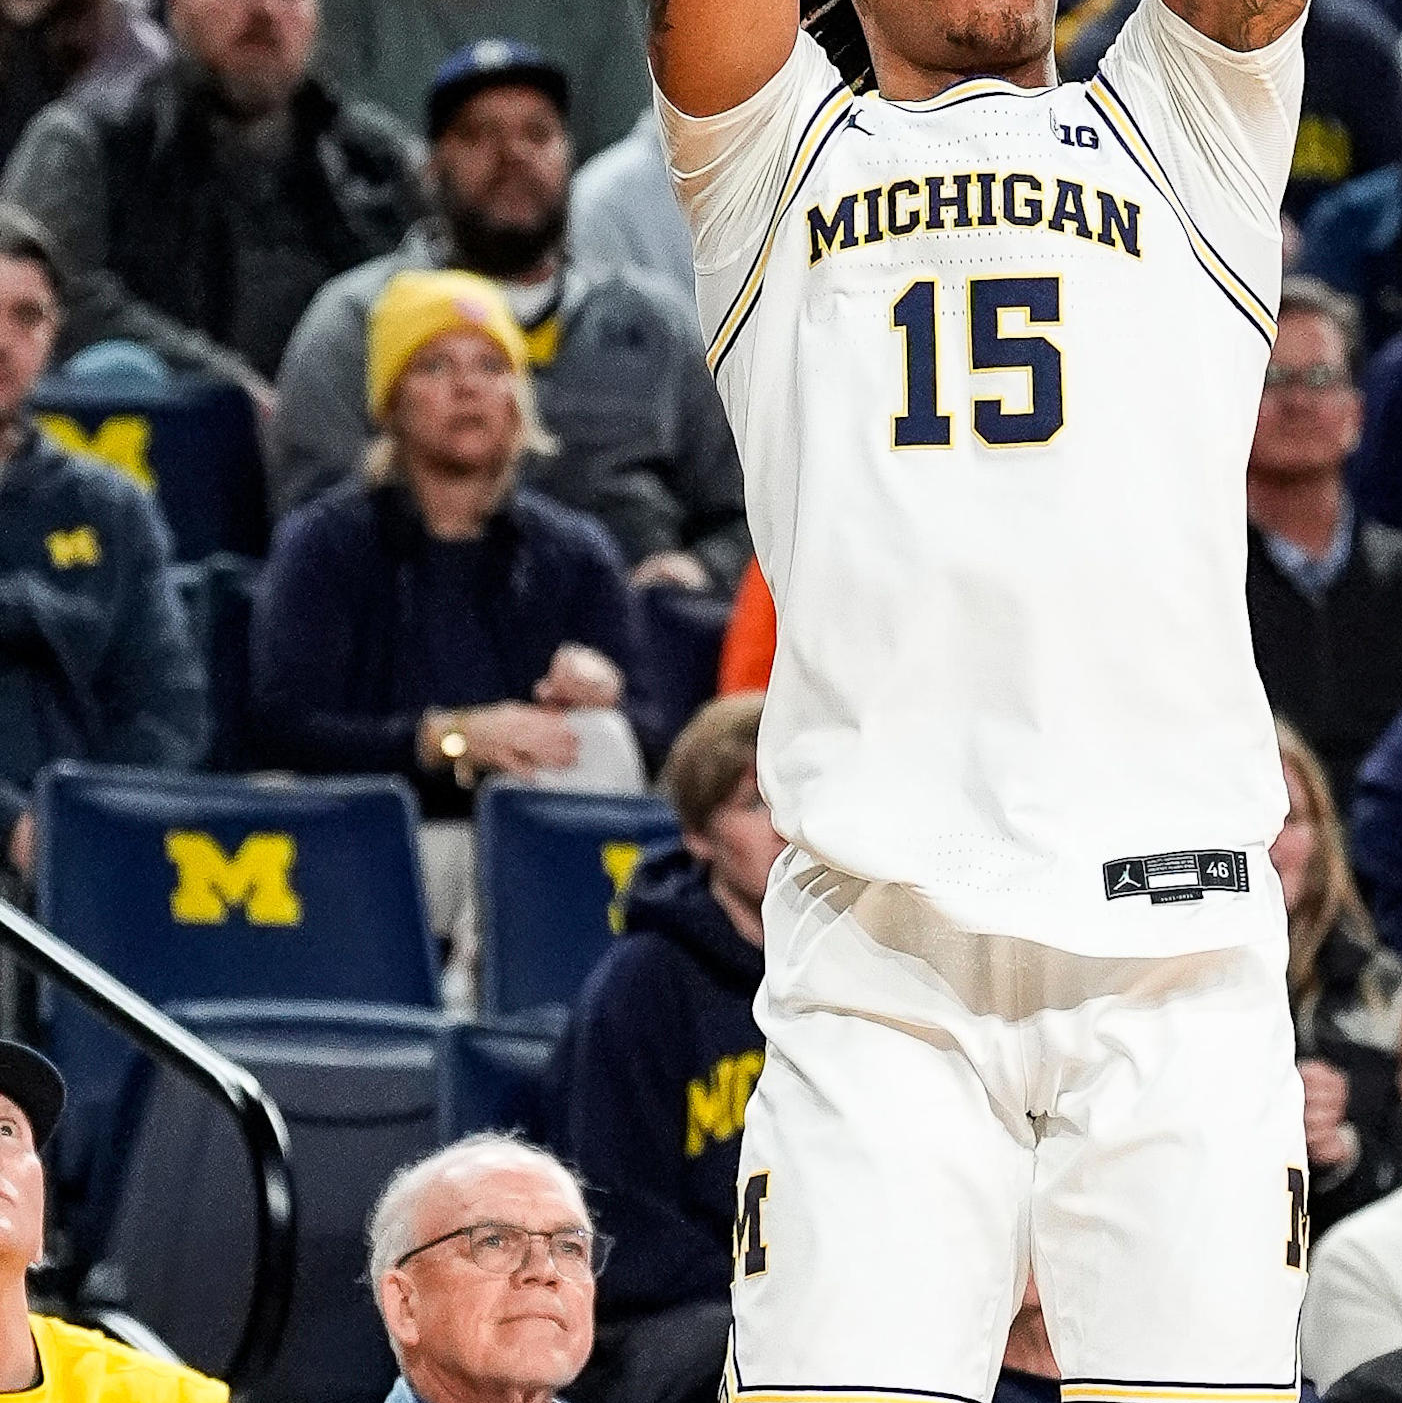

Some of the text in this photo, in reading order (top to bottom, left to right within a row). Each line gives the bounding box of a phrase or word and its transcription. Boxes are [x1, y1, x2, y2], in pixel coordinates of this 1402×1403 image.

[806, 172, 1143, 268] MICHIGAN
[890, 274, 1064, 451] 15
[44, 524, 101, 568] M
[163, 829, 302, 926] M
[1206, 860, 1230, 879] 46
